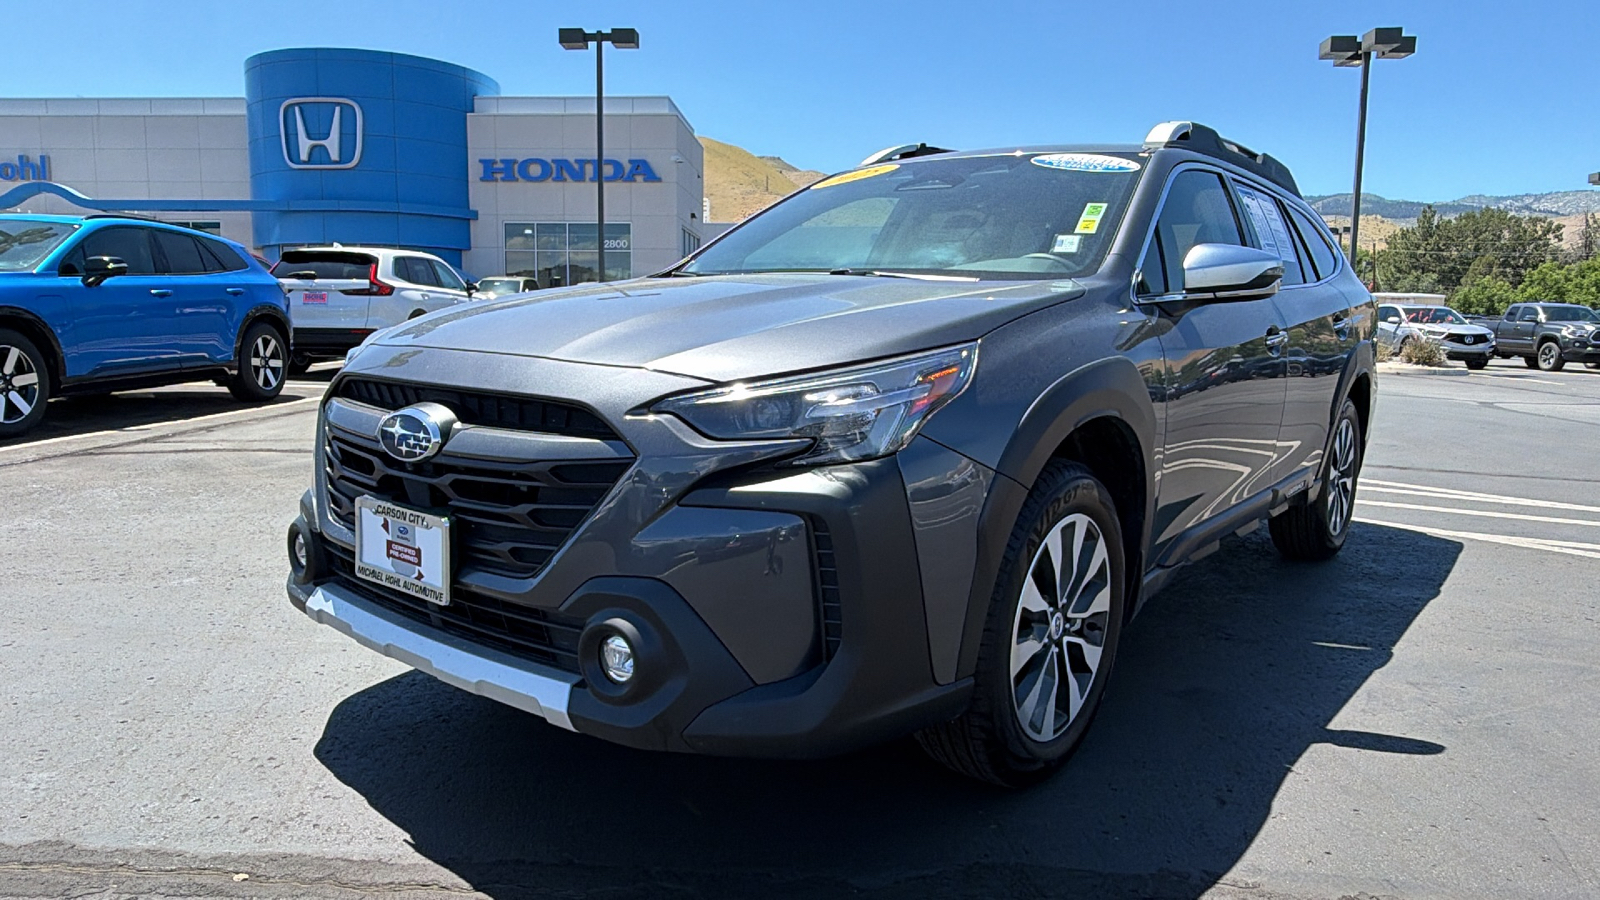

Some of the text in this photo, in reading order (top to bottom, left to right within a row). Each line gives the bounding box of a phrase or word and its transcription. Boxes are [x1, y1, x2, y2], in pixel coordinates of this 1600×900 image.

[0, 154, 48, 180] ohl
[478, 157, 663, 182] HONDA
[604, 239, 628, 248] 2800
[376, 505, 425, 526] CARSON CITY
[357, 565, 444, 603] MICHAEL HOHL AUTOMOTIVE
